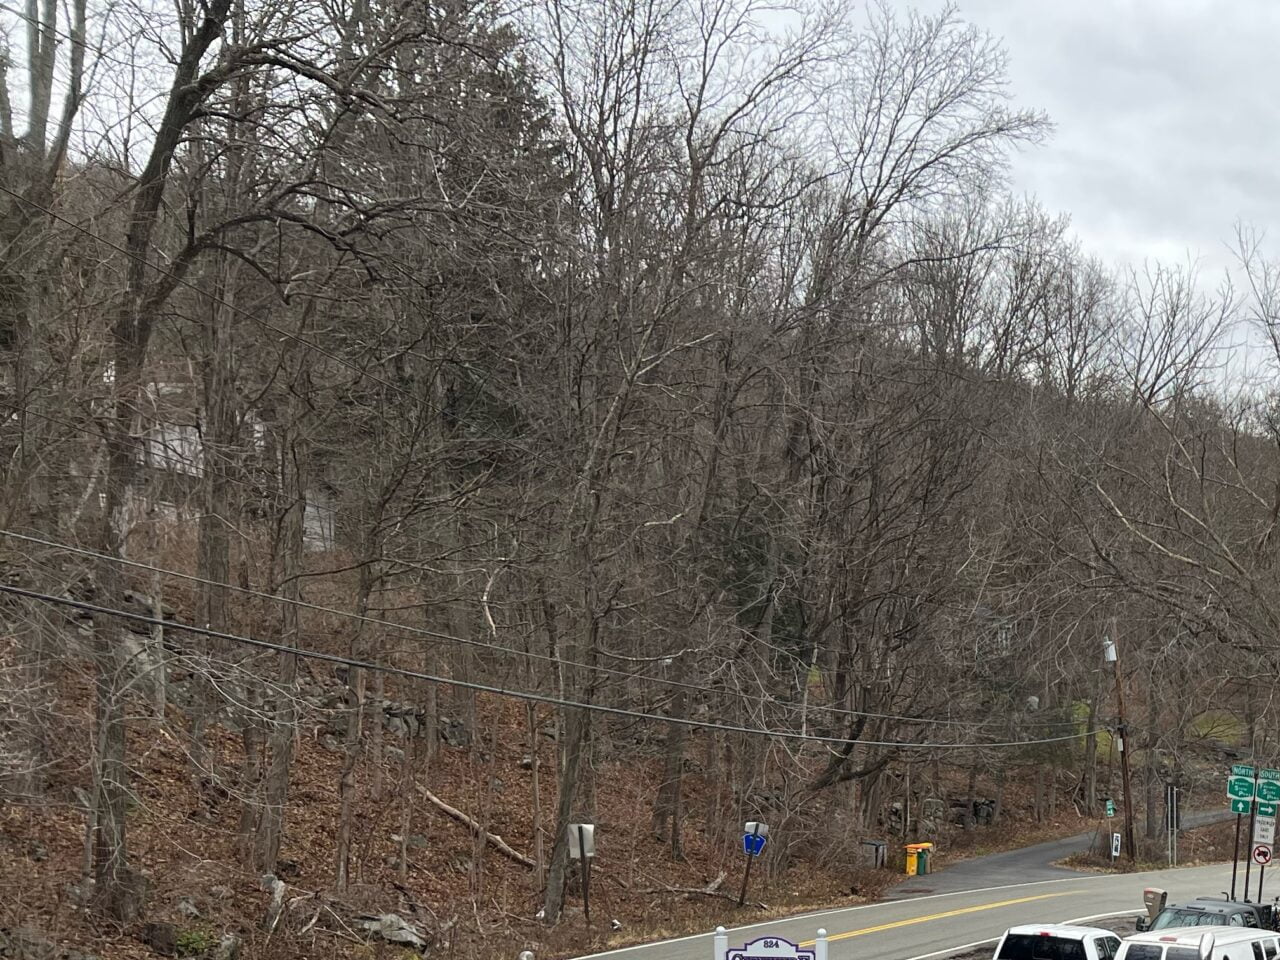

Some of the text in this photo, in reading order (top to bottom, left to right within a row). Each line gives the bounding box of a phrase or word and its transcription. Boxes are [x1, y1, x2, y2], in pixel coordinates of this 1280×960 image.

[1233, 766, 1253, 777] NORTH
[1260, 770, 1280, 779] SOUTH
[763, 940, 779, 949] 824
